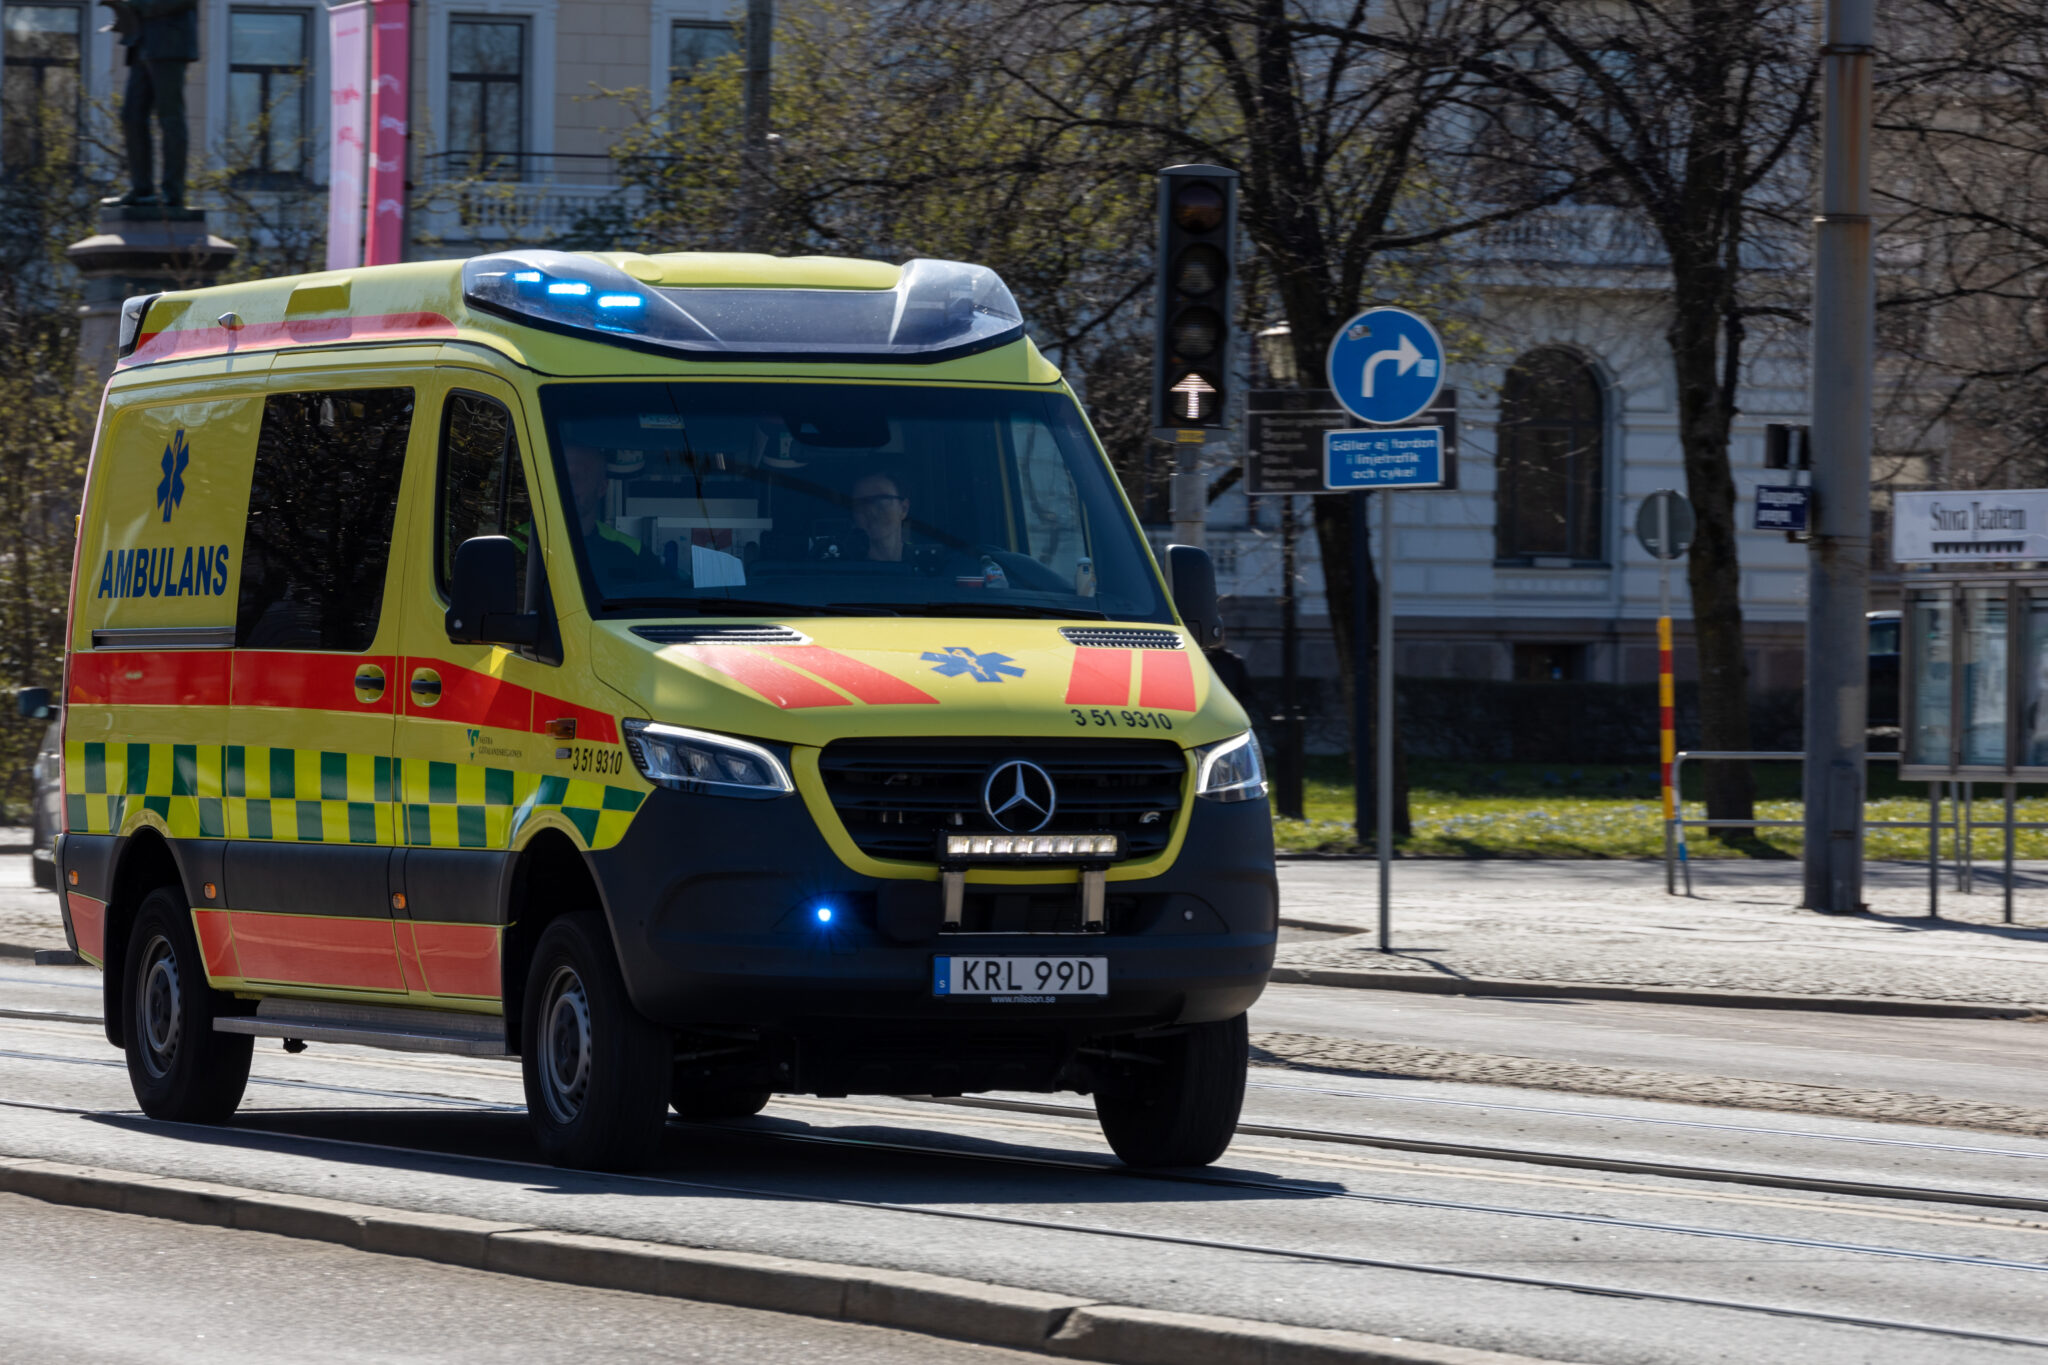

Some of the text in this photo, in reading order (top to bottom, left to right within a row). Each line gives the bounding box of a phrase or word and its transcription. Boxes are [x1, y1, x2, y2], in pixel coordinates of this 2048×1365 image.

[1331, 438, 1436, 452] Gäller ej fordon
[1354, 452, 1420, 466] linjetrafik
[1351, 467, 1417, 480] och cykel
[1930, 501, 2027, 539] Stora Teatern
[97, 544, 229, 599] AMBULANS
[1070, 708, 1173, 730] 3 51 9310
[573, 747, 623, 775] 3 51 9310
[939, 979, 946, 989] S
[962, 960, 1095, 991] KRL 99D
[991, 994, 1056, 1004] www.nilsson.se
